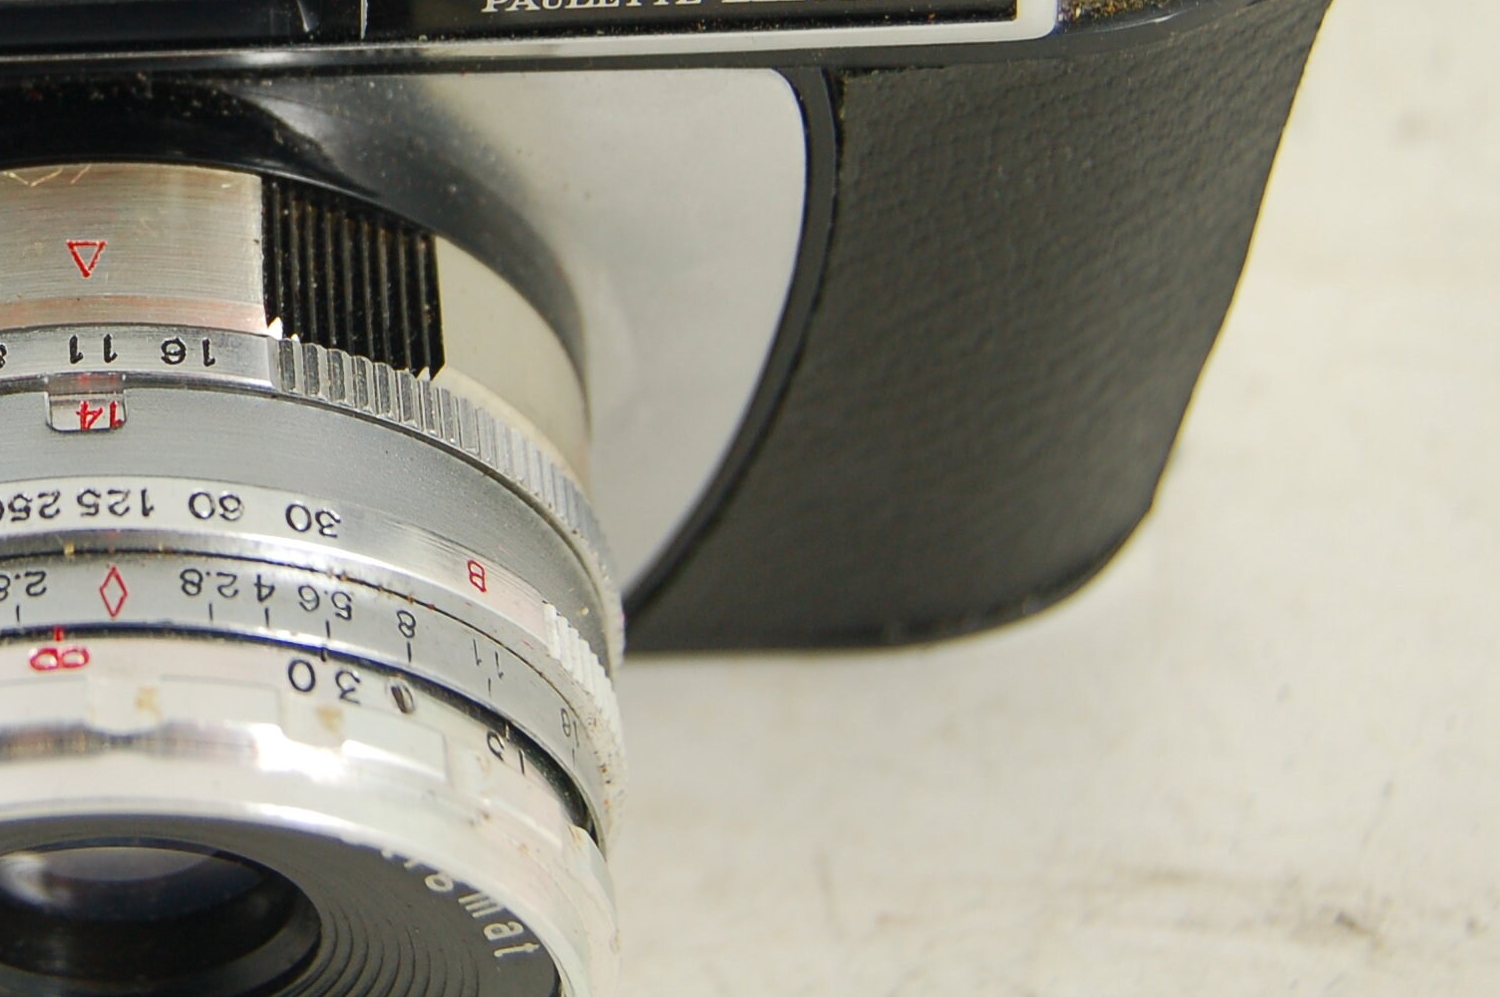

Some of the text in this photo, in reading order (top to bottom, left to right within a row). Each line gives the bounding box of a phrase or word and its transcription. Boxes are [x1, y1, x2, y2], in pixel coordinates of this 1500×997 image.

[68, 333, 119, 364] 11
[160, 335, 218, 368] 16
[75, 400, 124, 433] 14
[76, 487, 155, 518] 125
[187, 491, 245, 522] 60
[285, 502, 342, 539] 30
[179, 567, 240, 600] 2.8
[253, 574, 275, 602] 4
[466, 558, 488, 594] B
[299, 585, 353, 621] 5.6
[396, 609, 417, 640] 8
[287, 658, 362, 704] 30
